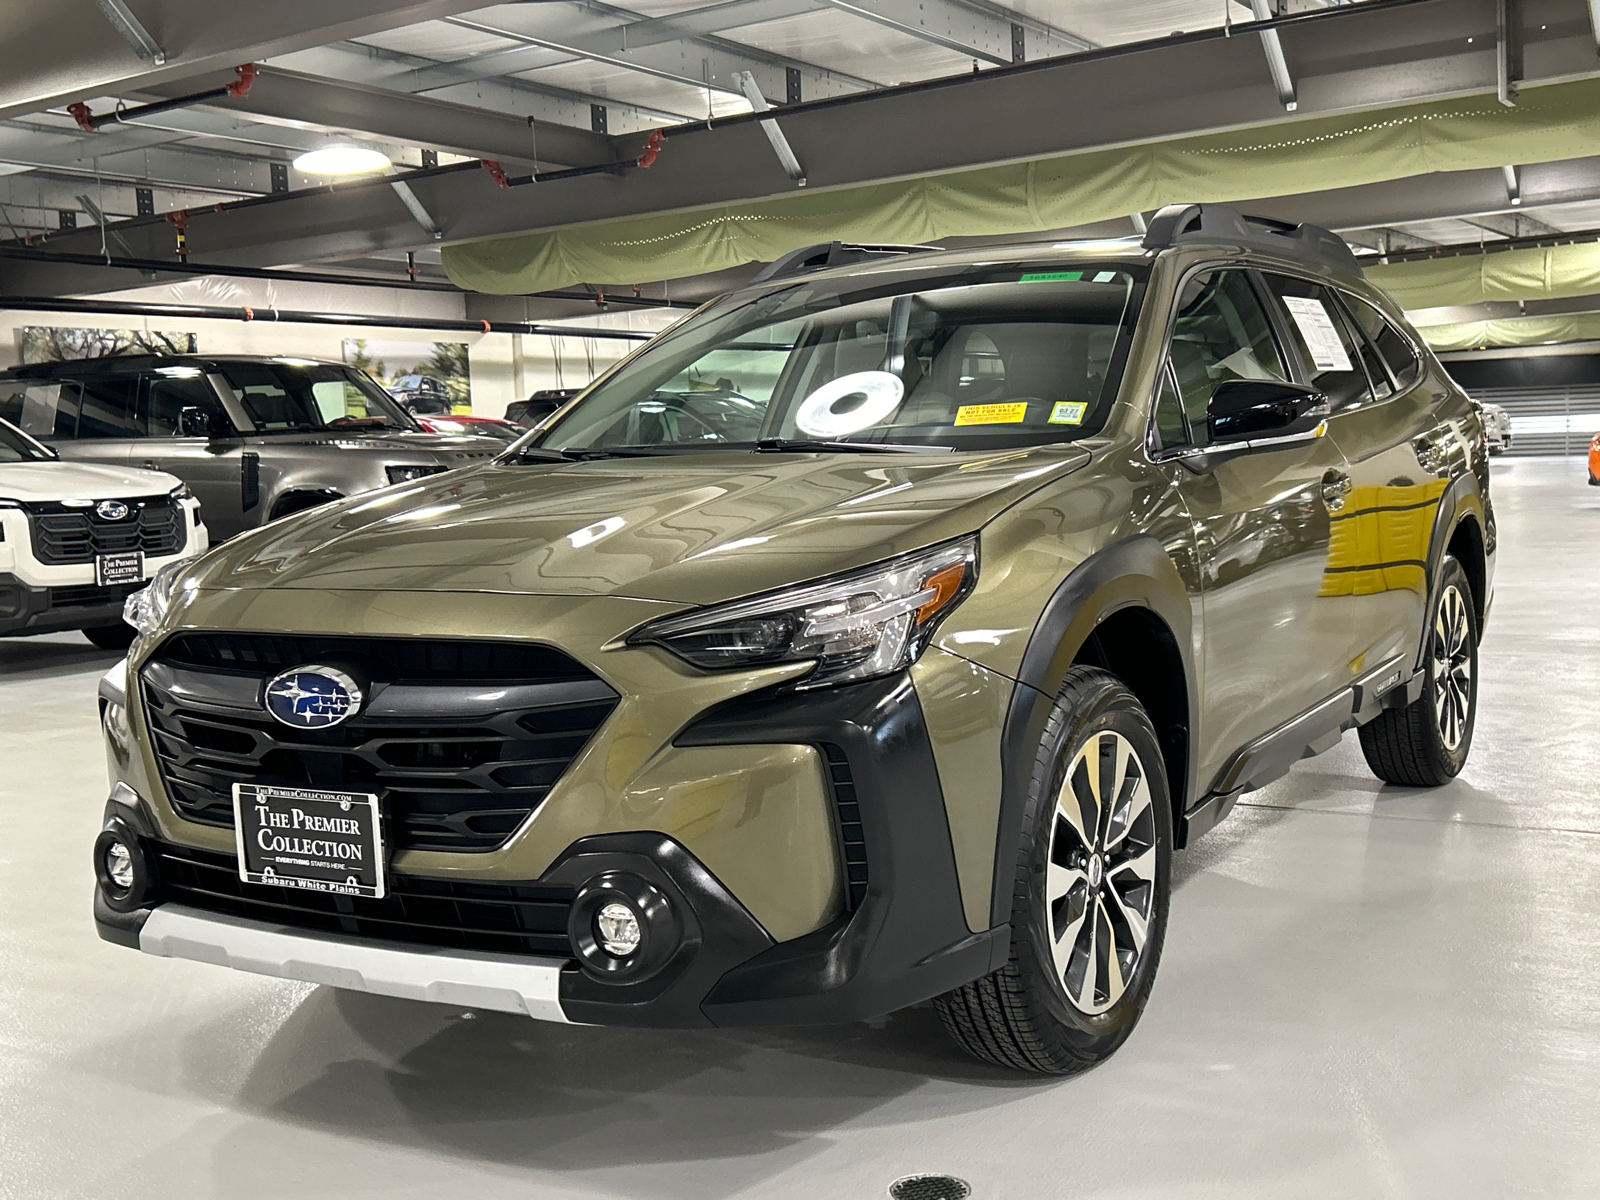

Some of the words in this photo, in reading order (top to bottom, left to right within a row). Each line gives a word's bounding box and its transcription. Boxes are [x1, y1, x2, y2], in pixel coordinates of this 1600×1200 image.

[254, 805, 290, 828] THE
[291, 808, 361, 836] PREMIER
[257, 828, 363, 861] COLLECTION
[310, 860, 331, 869] STARTS
[261, 875, 295, 886] Subaru
[297, 879, 327, 890] White
[329, 883, 361, 894] Plains
